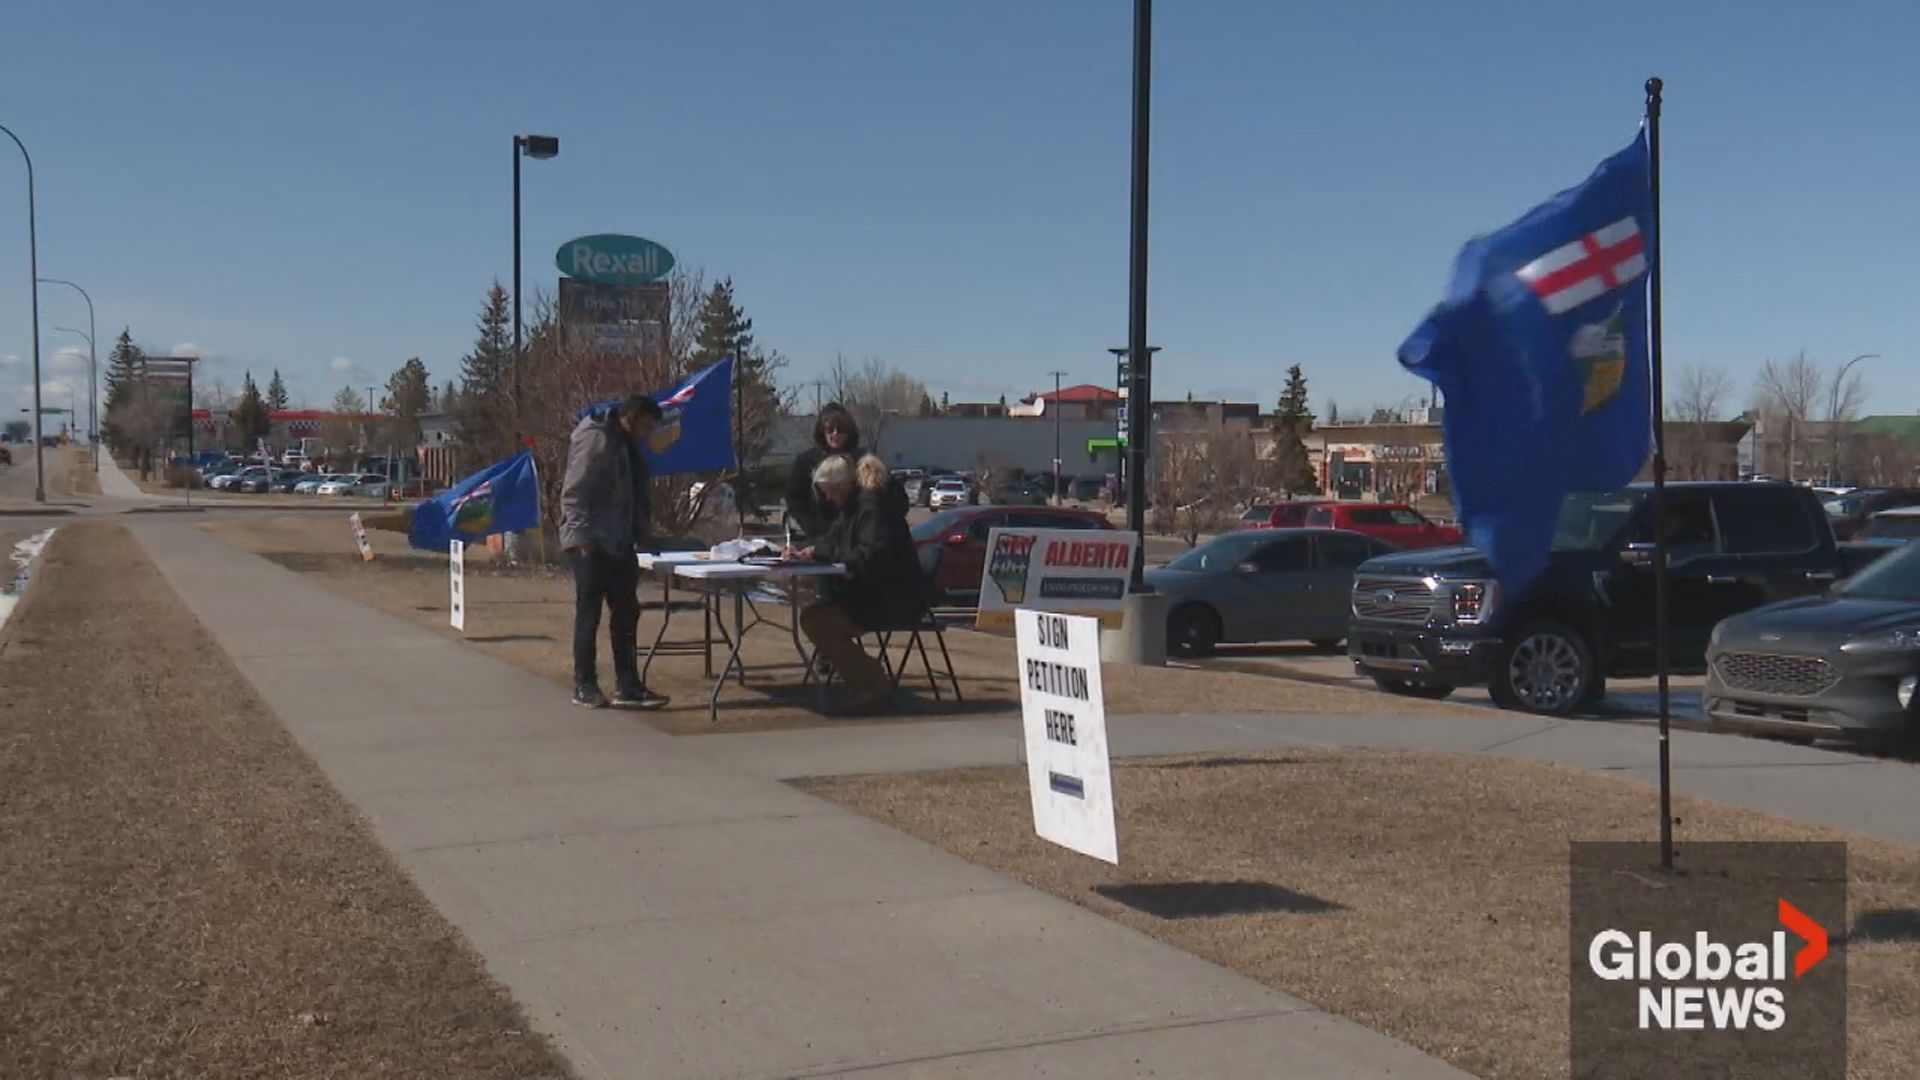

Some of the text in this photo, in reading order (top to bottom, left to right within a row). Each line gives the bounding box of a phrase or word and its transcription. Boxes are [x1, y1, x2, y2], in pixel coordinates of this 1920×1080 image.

[573, 245, 659, 277] Rexall
[1044, 539, 1129, 569] ALBERTA
[1037, 614, 1070, 650] SIGN
[1026, 658, 1089, 701] PETITION
[1045, 708, 1077, 746] HERE
